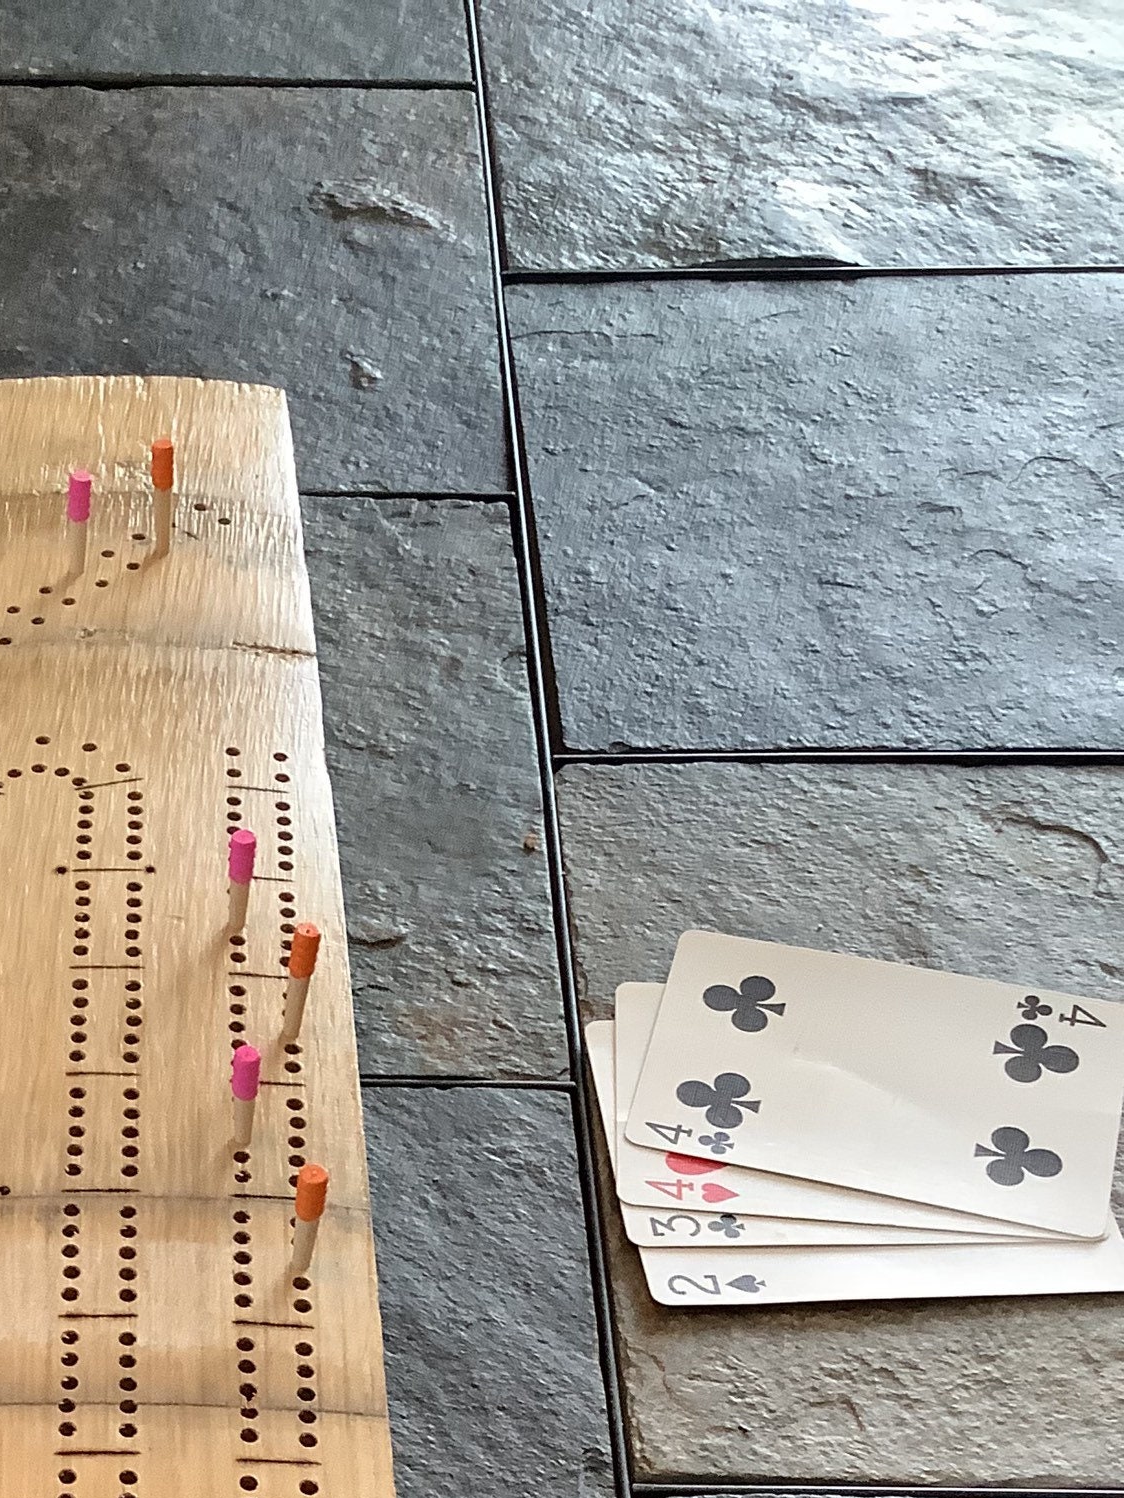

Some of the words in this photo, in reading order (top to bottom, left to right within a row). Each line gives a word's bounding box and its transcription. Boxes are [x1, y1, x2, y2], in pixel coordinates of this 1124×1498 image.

[1058, 1003, 1108, 1028] 4
[645, 1120, 693, 1145] 4
[645, 1178, 695, 1201] 4
[650, 1214, 702, 1238] 3
[668, 1273, 721, 1296] 2
